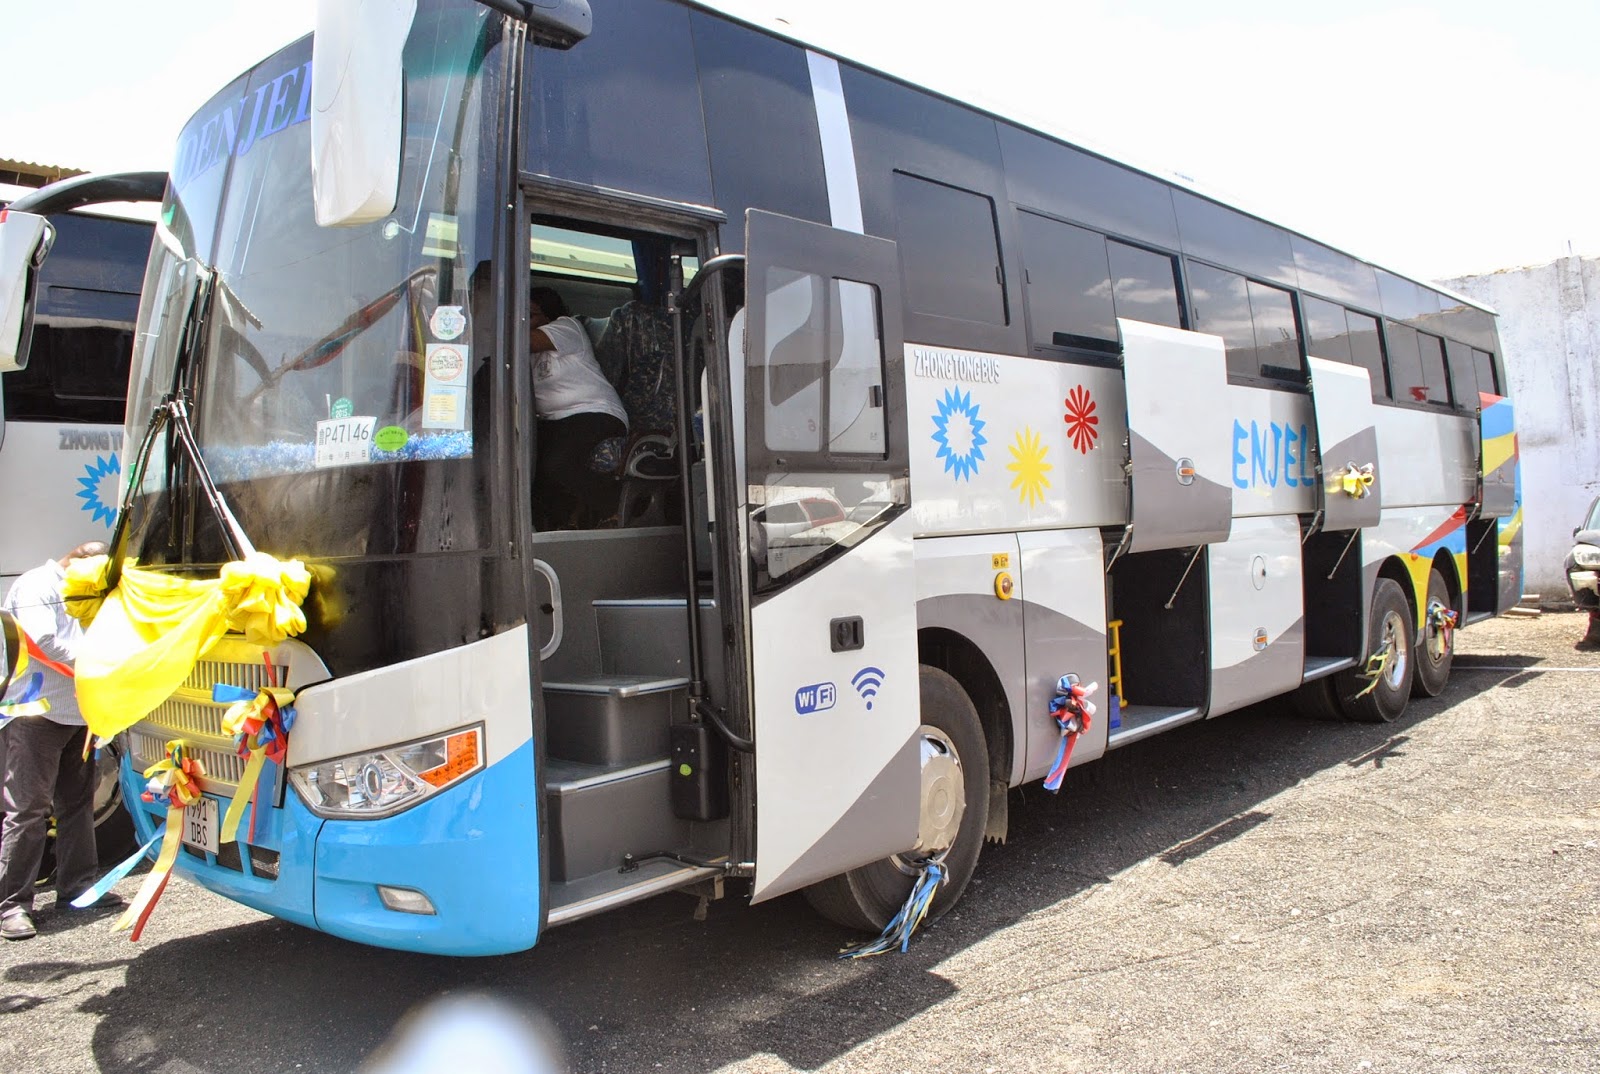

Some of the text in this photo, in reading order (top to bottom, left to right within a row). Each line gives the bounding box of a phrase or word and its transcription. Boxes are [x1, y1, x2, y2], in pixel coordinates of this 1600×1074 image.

[335, 408, 348, 418] 2015
[1232, 418, 1315, 489] ENJEL
[191, 822, 208, 846] DBS
